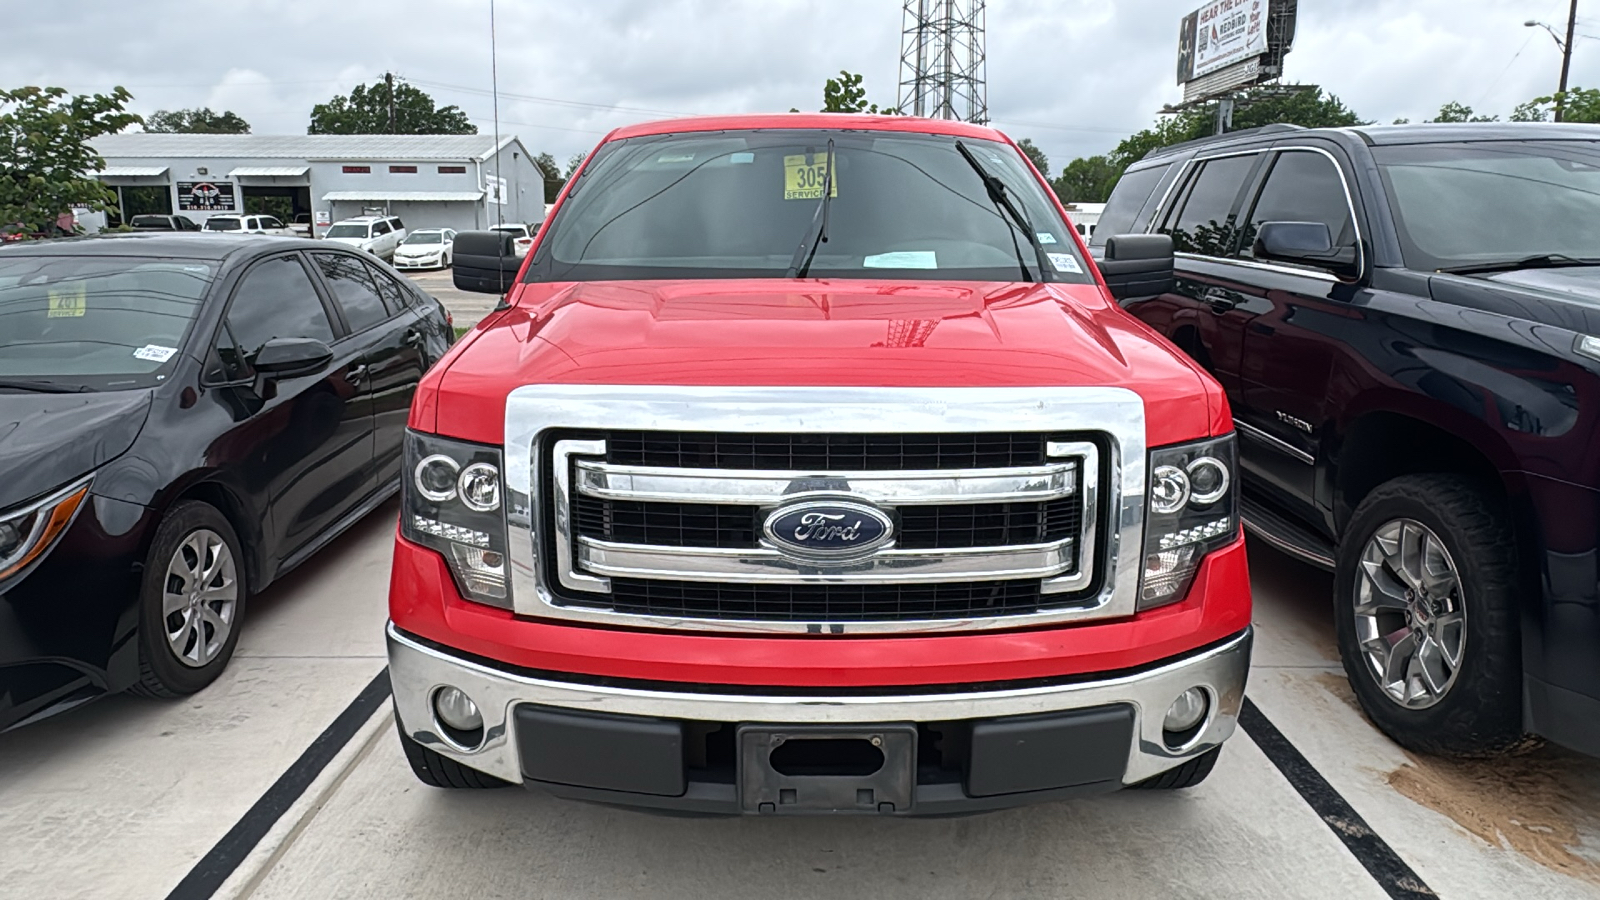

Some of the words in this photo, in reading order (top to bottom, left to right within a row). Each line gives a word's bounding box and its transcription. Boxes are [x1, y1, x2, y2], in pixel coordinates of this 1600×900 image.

[1200, 4, 1219, 25] HEAR
[1220, 0, 1233, 14] THE
[797, 166, 826, 189] 305
[794, 512, 862, 541] Ford
